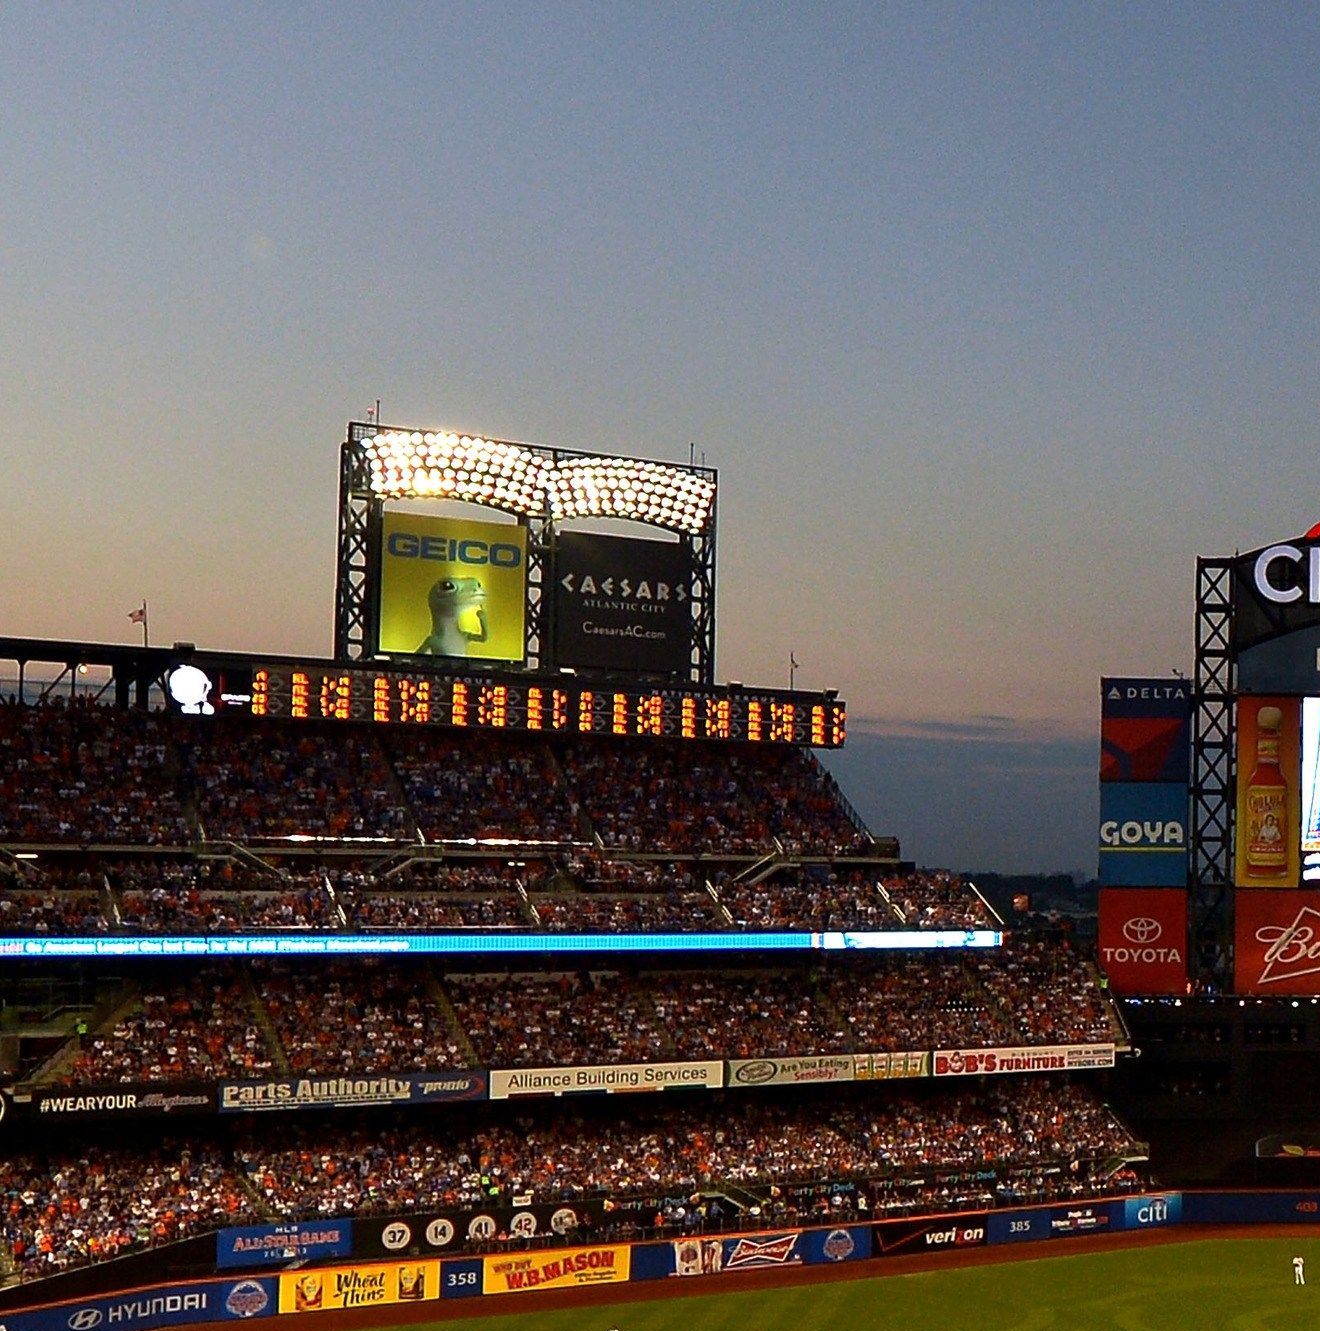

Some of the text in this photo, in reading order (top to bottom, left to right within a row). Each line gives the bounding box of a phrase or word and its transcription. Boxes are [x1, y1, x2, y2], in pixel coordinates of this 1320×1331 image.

[387, 532, 521, 567] GEICO
[561, 574, 686, 601] CAESARS
[582, 600, 637, 612] ATLANTIC
[582, 621, 666, 639] CaesarsAC.com
[1126, 687, 1185, 699] DELTA
[1100, 821, 1184, 846] GOYA
[1103, 948, 1181, 963] TOYOTA
[780, 1063, 797, 1074] Are
[799, 1060, 816, 1070] You
[818, 1058, 849, 1070] Eating
[1000, 1056, 1065, 1071] FURNITURE
[508, 1066, 707, 1088] Alliance Building Services
[223, 1078, 411, 1101] Parts Authority
[40, 1094, 137, 1113] #WEARYOUR
[1138, 1200, 1167, 1222] citi
[434, 1226, 446, 1239] 14
[475, 1222, 489, 1234] 41
[515, 1218, 532, 1231] 42
[1009, 1220, 1030, 1233] 385
[388, 1229, 405, 1243] 37
[925, 1228, 984, 1244] verizon
[337, 1270, 385, 1291] Wheat
[448, 1272, 477, 1286] 358
[333, 1287, 384, 1307] Thins
[108, 1293, 207, 1323] HYUNDAI
